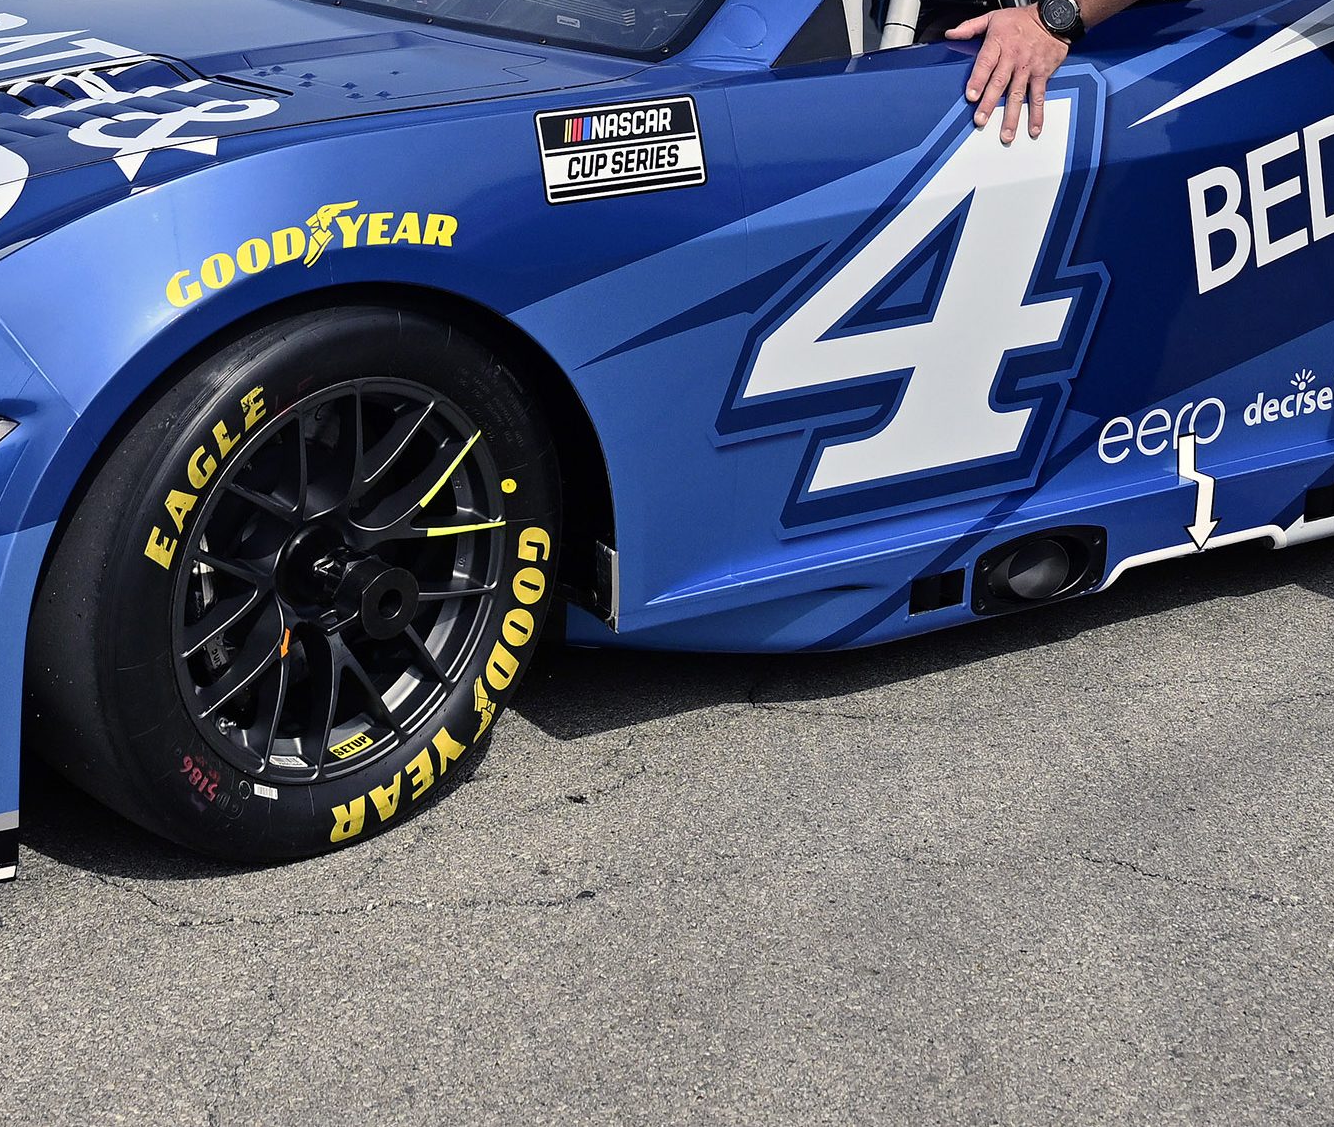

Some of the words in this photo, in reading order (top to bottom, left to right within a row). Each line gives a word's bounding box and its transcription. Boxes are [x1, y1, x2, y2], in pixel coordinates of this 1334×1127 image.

[590, 107, 673, 139] NASCAR
[567, 151, 608, 181] CUP
[611, 144, 680, 175] SERIES
[743, 96, 1073, 493] 4
[1097, 397, 1226, 465] eero
[144, 386, 267, 570] EAGLE
[333, 734, 369, 758] SETUP
